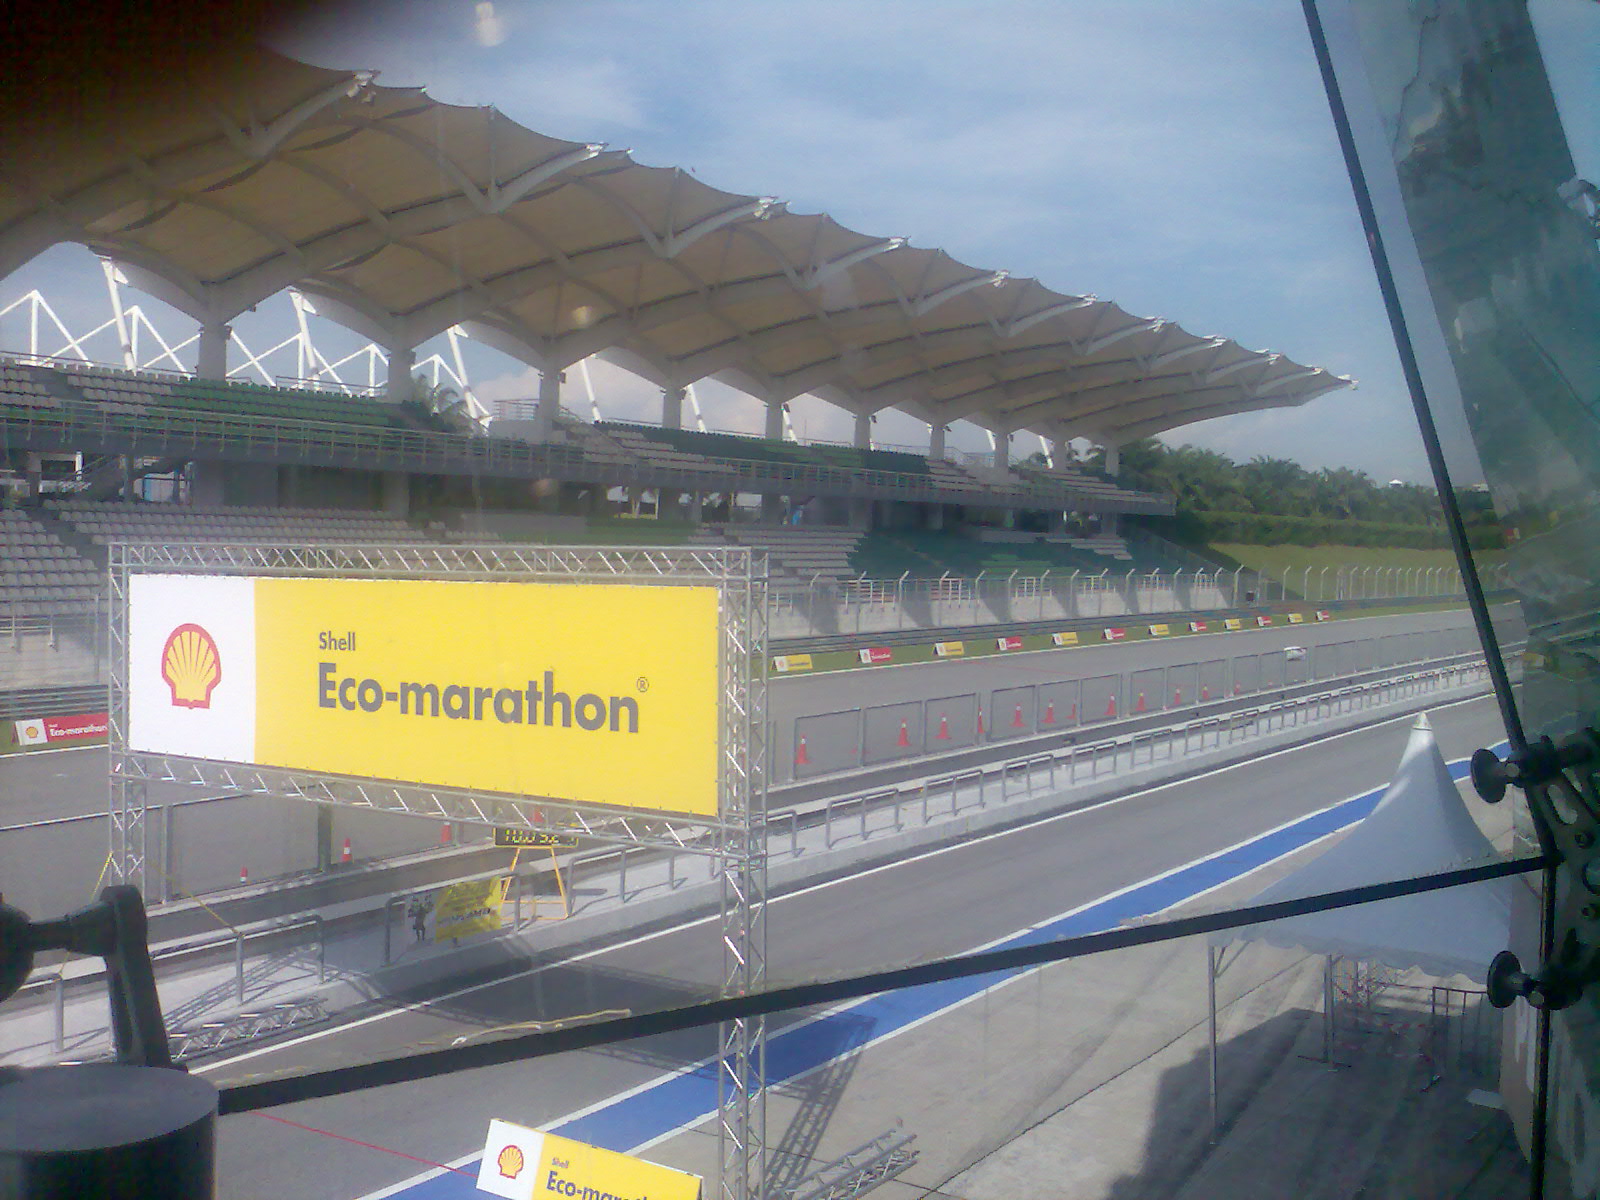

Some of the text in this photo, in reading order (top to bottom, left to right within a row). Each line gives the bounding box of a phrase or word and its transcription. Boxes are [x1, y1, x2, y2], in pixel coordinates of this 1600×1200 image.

[318, 630, 356, 651] Shell
[552, 1156, 570, 1169] Shell
[546, 1170, 648, 1200] Eco-ma
